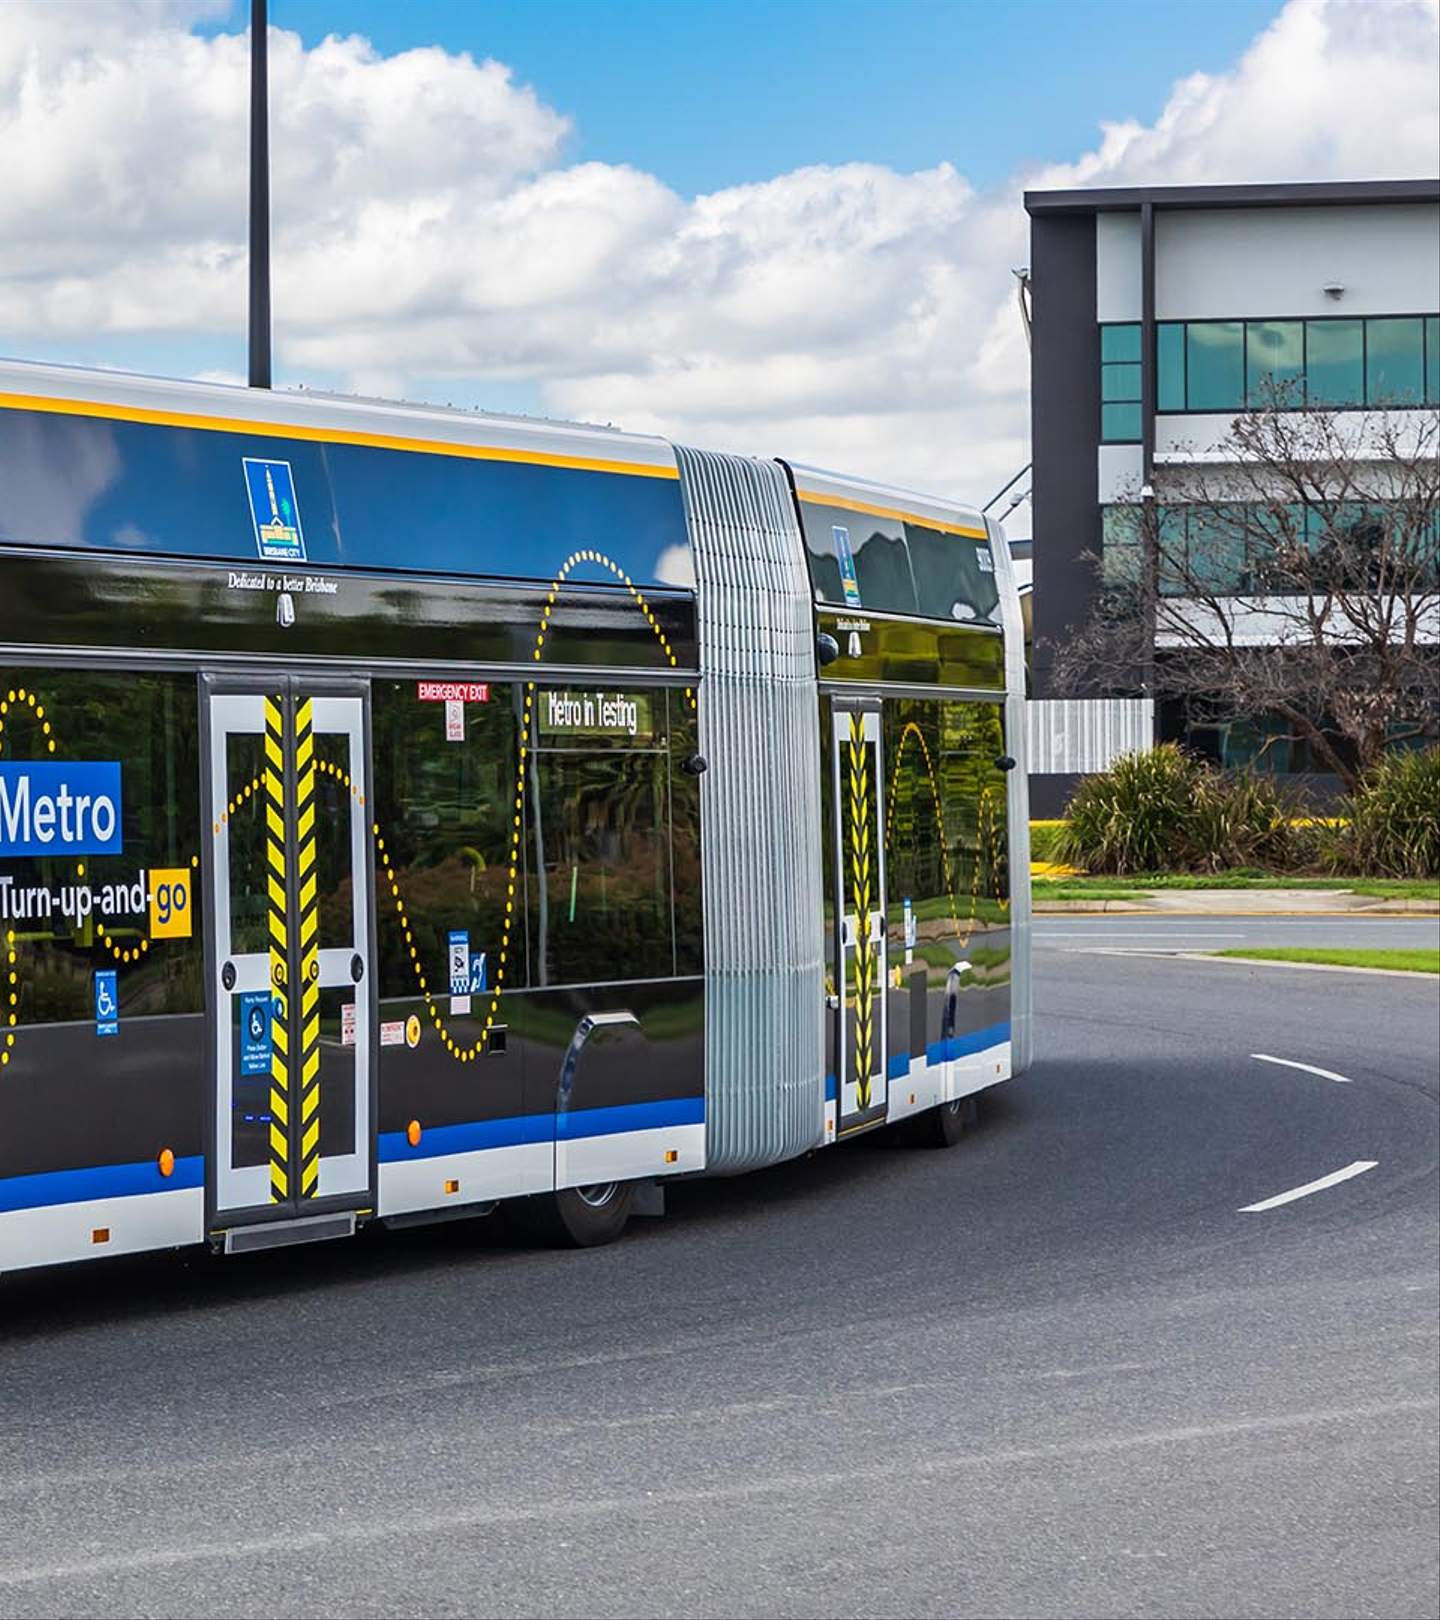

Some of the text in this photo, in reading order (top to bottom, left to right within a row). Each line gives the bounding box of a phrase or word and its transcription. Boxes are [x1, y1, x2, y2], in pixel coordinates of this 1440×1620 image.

[305, 576, 338, 593] Brisbane
[419, 683, 488, 700] EMERGENCY EXIT
[548, 691, 637, 735] Metro in Testing
